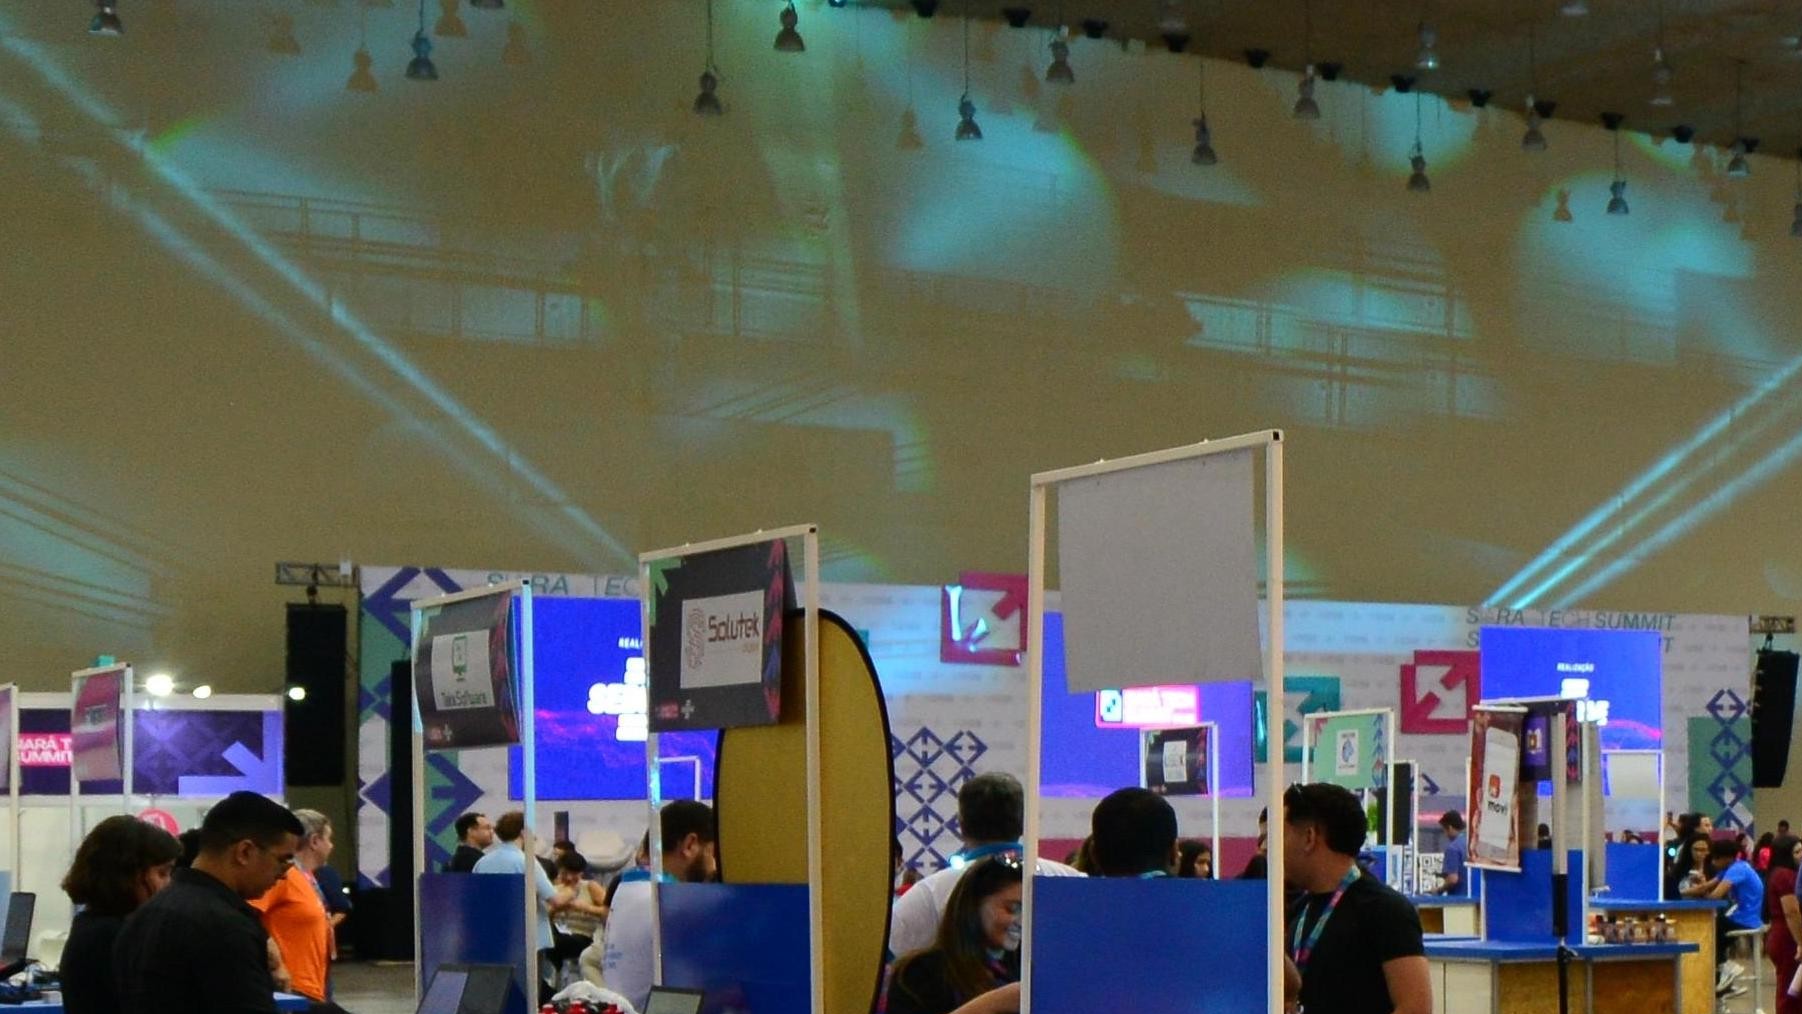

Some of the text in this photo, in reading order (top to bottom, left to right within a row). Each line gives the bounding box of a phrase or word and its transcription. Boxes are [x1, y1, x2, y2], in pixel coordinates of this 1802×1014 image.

[708, 611, 760, 642] Solutek
[1594, 611, 1676, 631] SUMMIT
[20, 750, 73, 763] UMMIT
